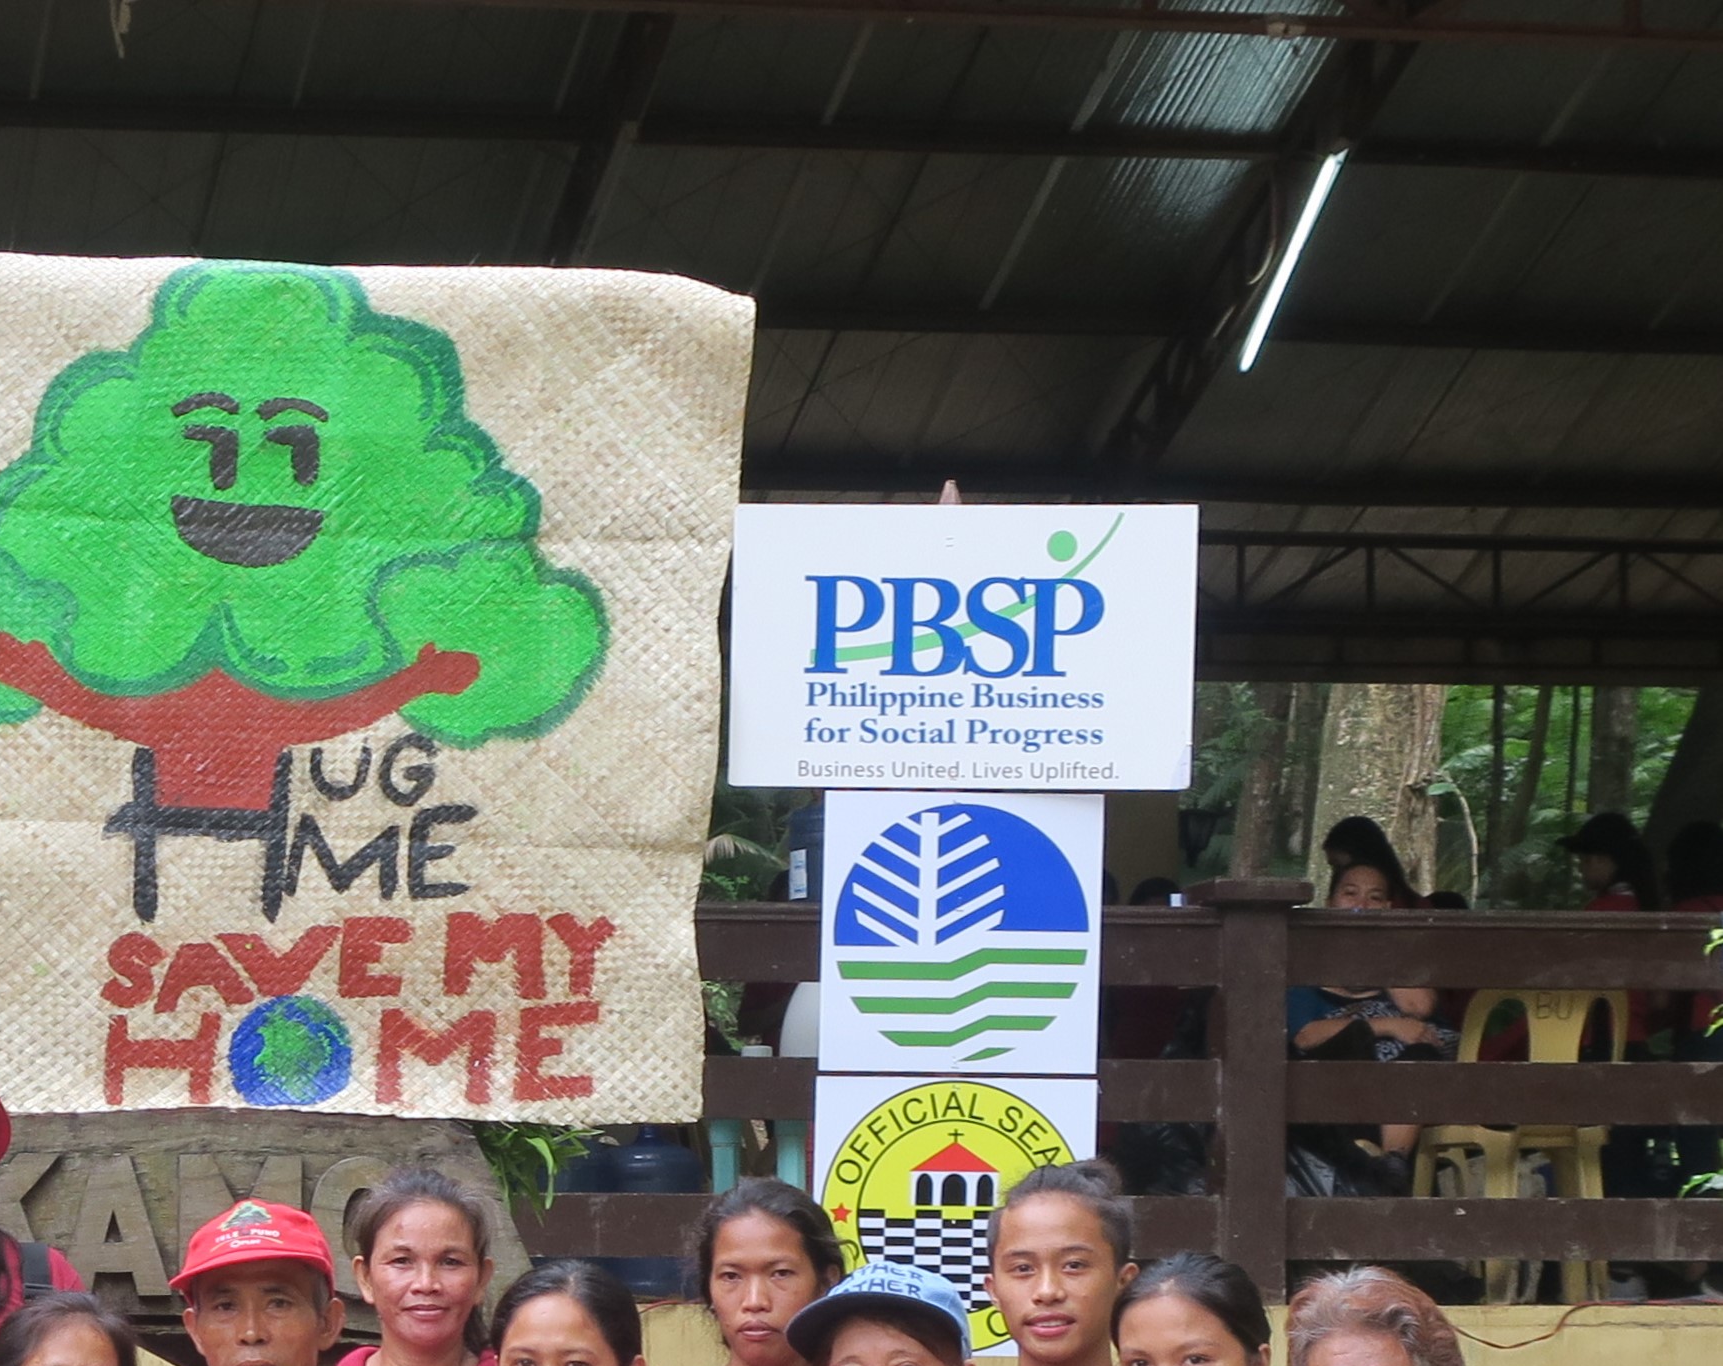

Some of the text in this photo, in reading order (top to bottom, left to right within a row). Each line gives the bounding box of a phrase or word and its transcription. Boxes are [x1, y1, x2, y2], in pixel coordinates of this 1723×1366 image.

[804, 574, 1105, 679] PBSP
[803, 717, 1104, 753] for Social Progress
[805, 681, 1104, 716] Philippine Business
[797, 760, 1120, 783] Business United. Lives Uplifted.
[102, 733, 439, 923] HUG
[283, 804, 477, 899] ME
[101, 911, 617, 1014] SAVE MY
[835, 1091, 1063, 1185] OFFICIAL SEA
